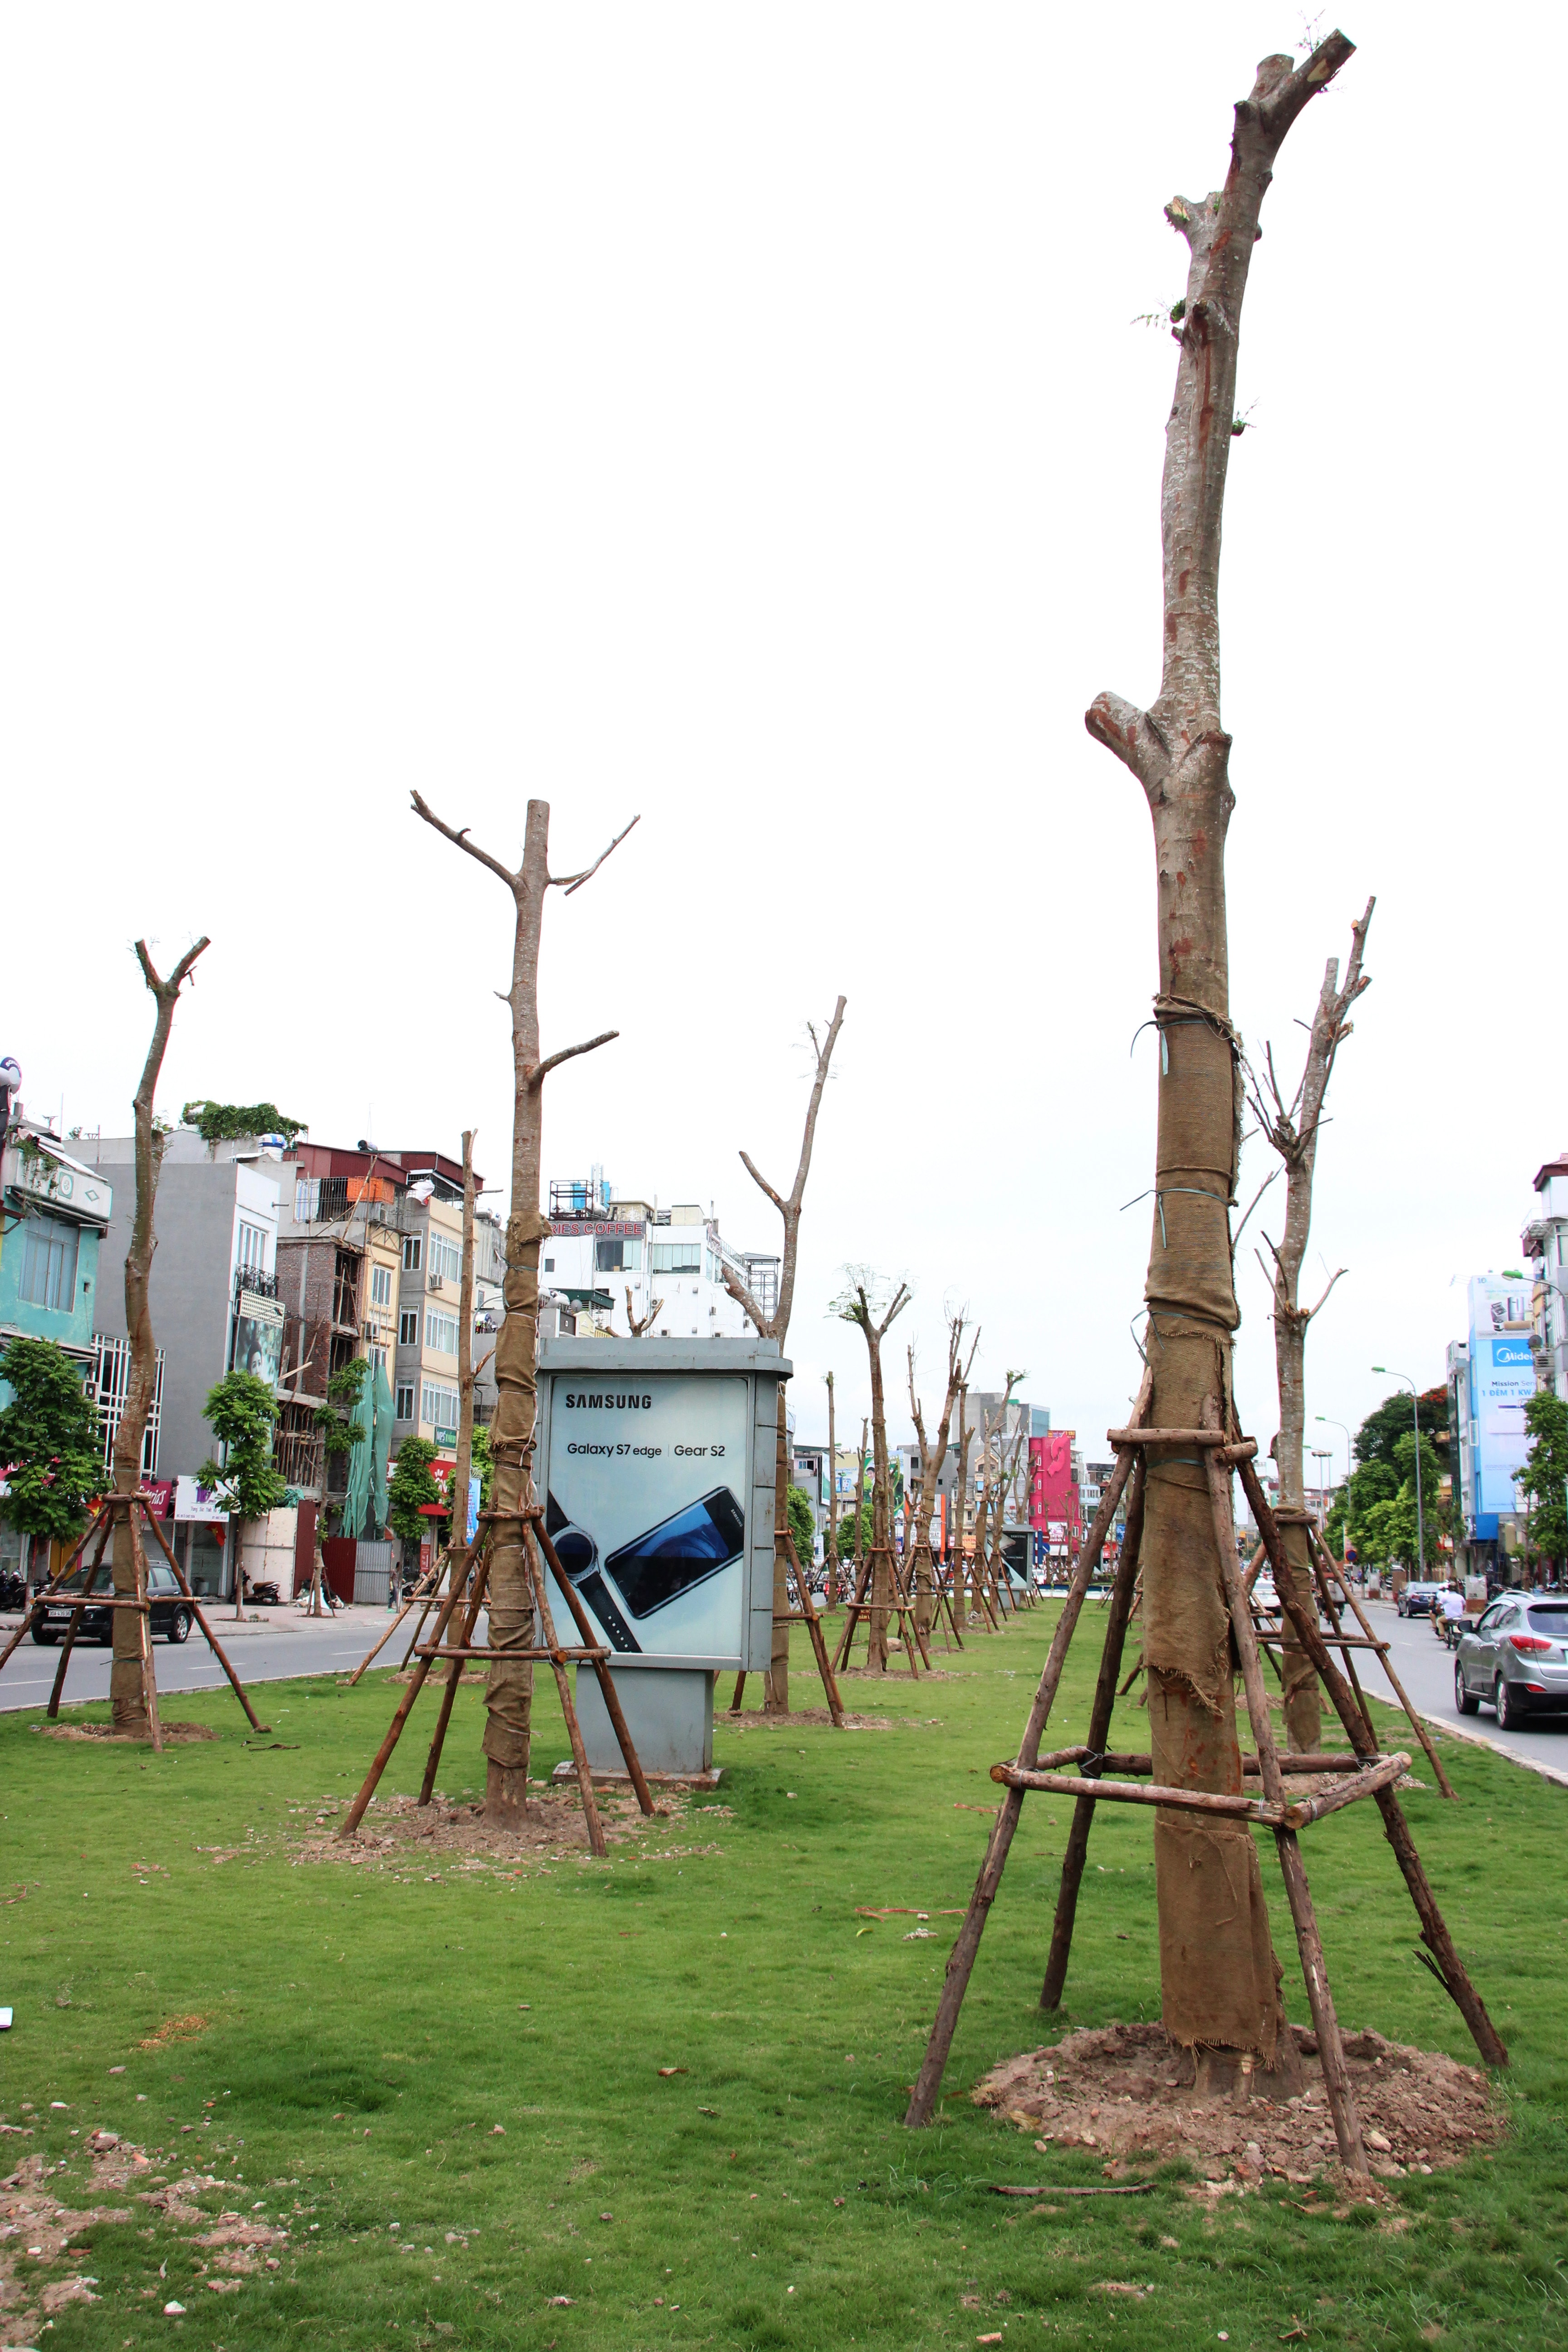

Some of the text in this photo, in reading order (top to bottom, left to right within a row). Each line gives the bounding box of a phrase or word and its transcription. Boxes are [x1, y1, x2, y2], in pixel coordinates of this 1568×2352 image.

[583, 1223, 642, 1235] COFFEE
[565, 1394, 652, 1409] SAMSUNG
[567, 1443, 725, 1459] Galaxy S7 edge Gear S2
[731, 1509, 743, 1527] SAMSUNG
